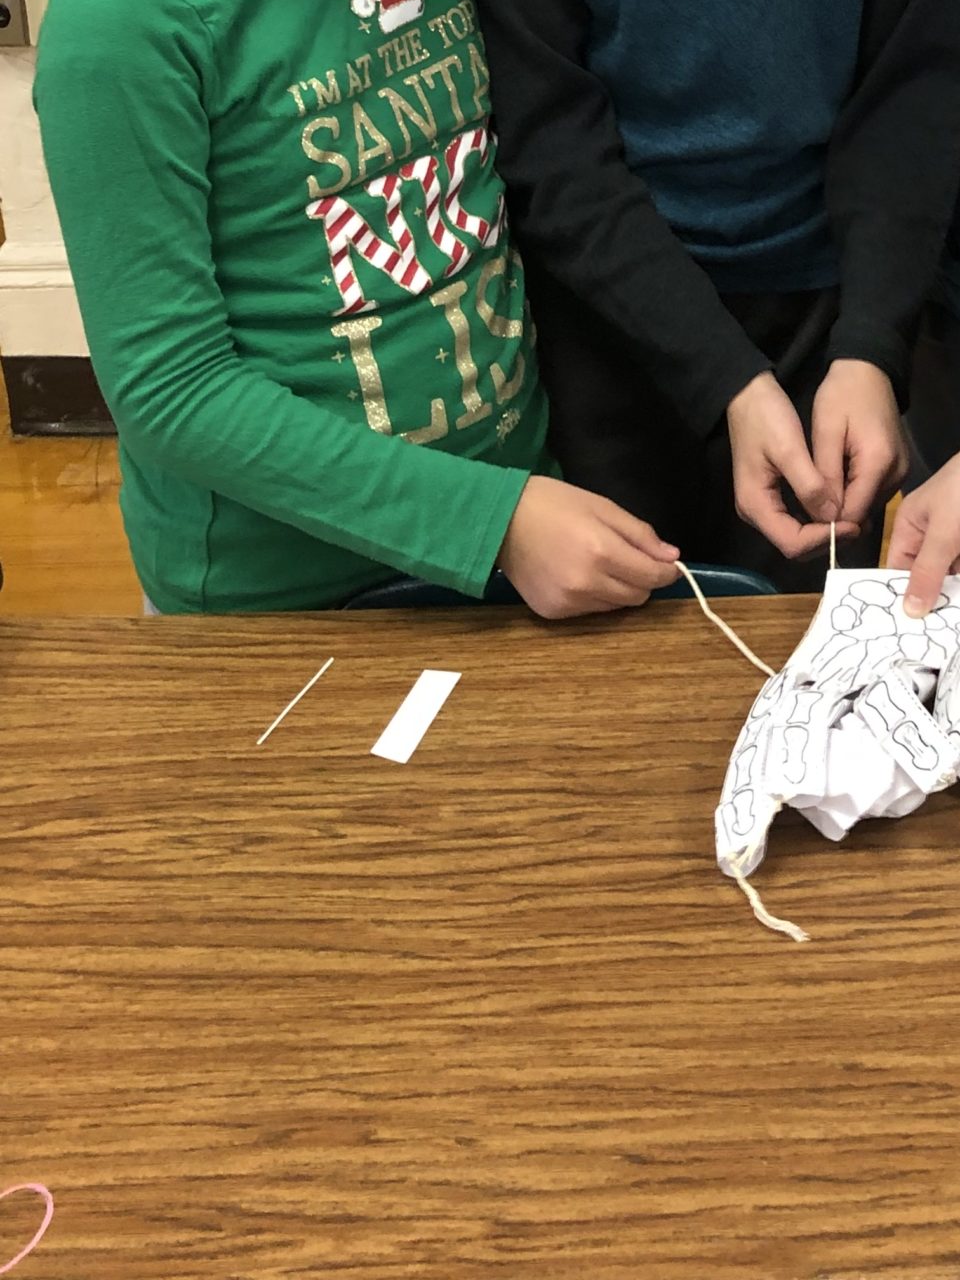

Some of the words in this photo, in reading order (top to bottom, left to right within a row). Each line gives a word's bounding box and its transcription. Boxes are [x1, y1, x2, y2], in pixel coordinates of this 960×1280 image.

[287, 69, 343, 118] I'M
[346, 53, 373, 98] AT
[377, 28, 431, 78] THE
[427, 0, 476, 49] TOP
[305, 126, 508, 318] NIC
